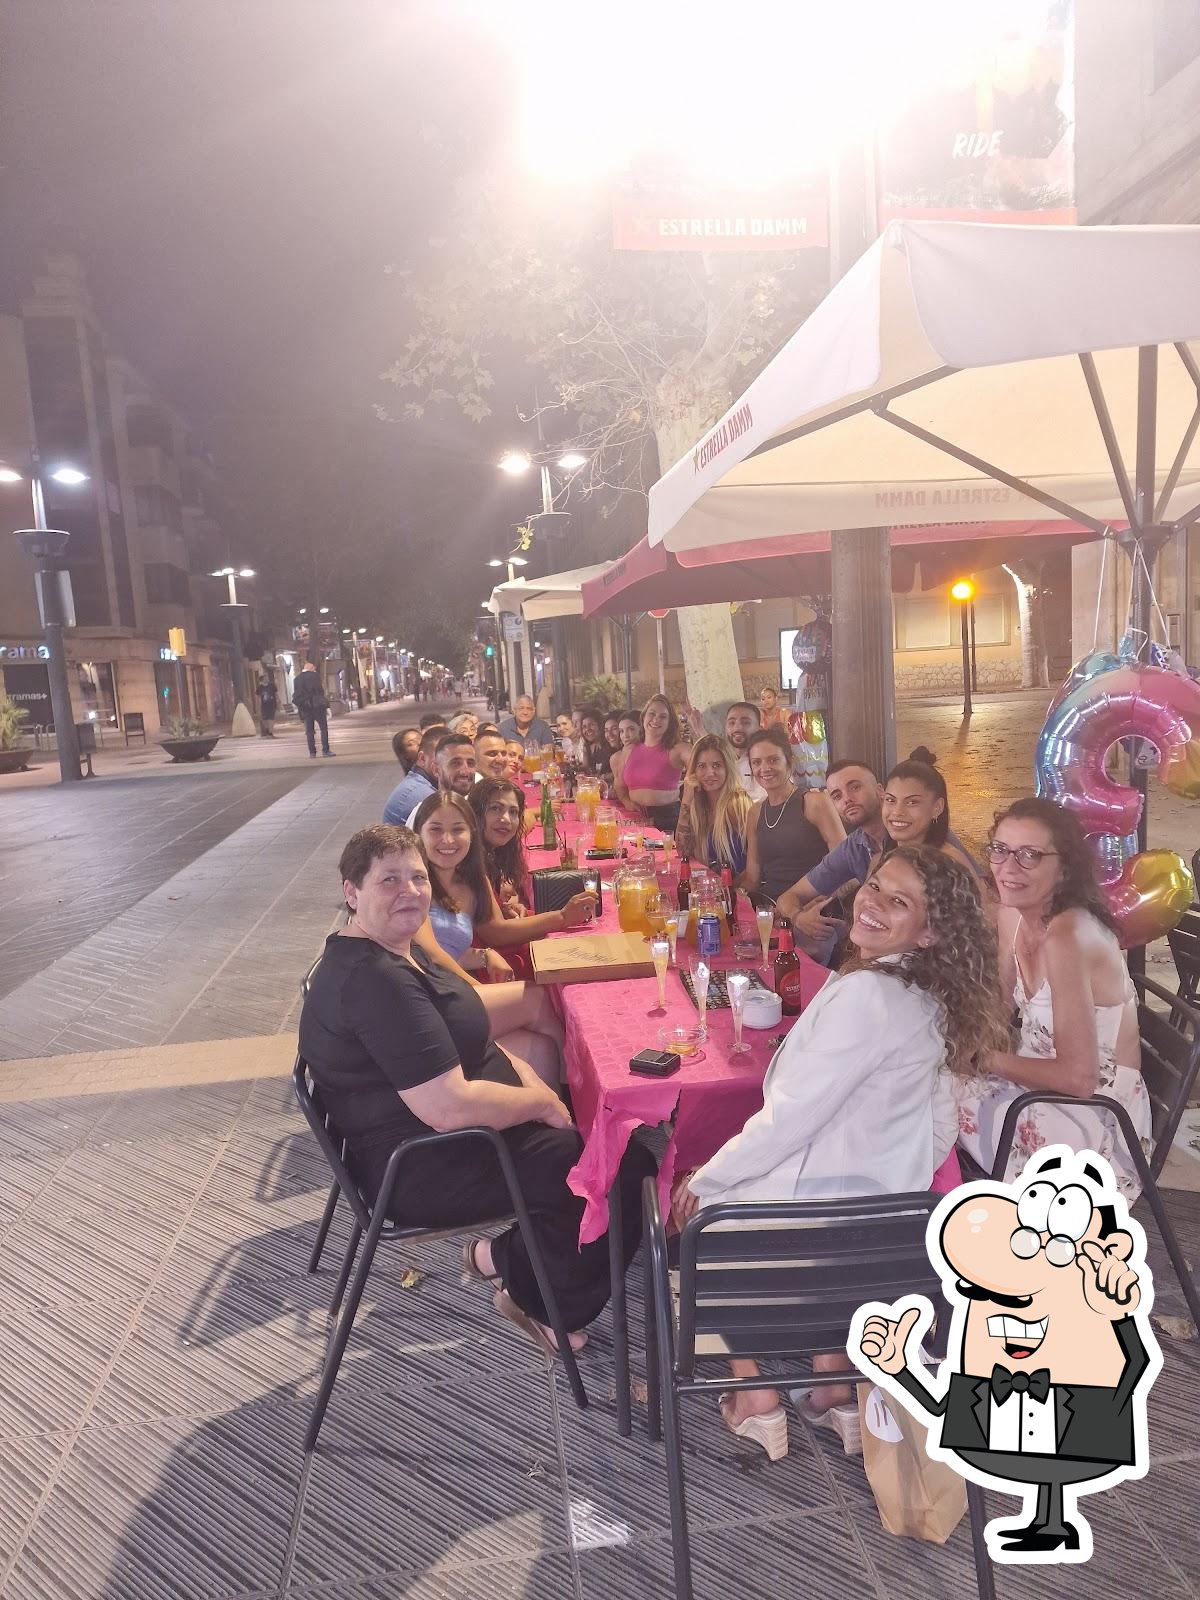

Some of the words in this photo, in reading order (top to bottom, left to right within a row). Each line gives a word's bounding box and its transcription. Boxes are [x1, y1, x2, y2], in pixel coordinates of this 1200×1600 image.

[952, 130, 1004, 159] RIDE
[659, 217, 747, 237] ESTRELLA
[751, 216, 808, 236] DAMM
[700, 425, 729, 469] ESTRELLA
[727, 403, 753, 443] DAMM
